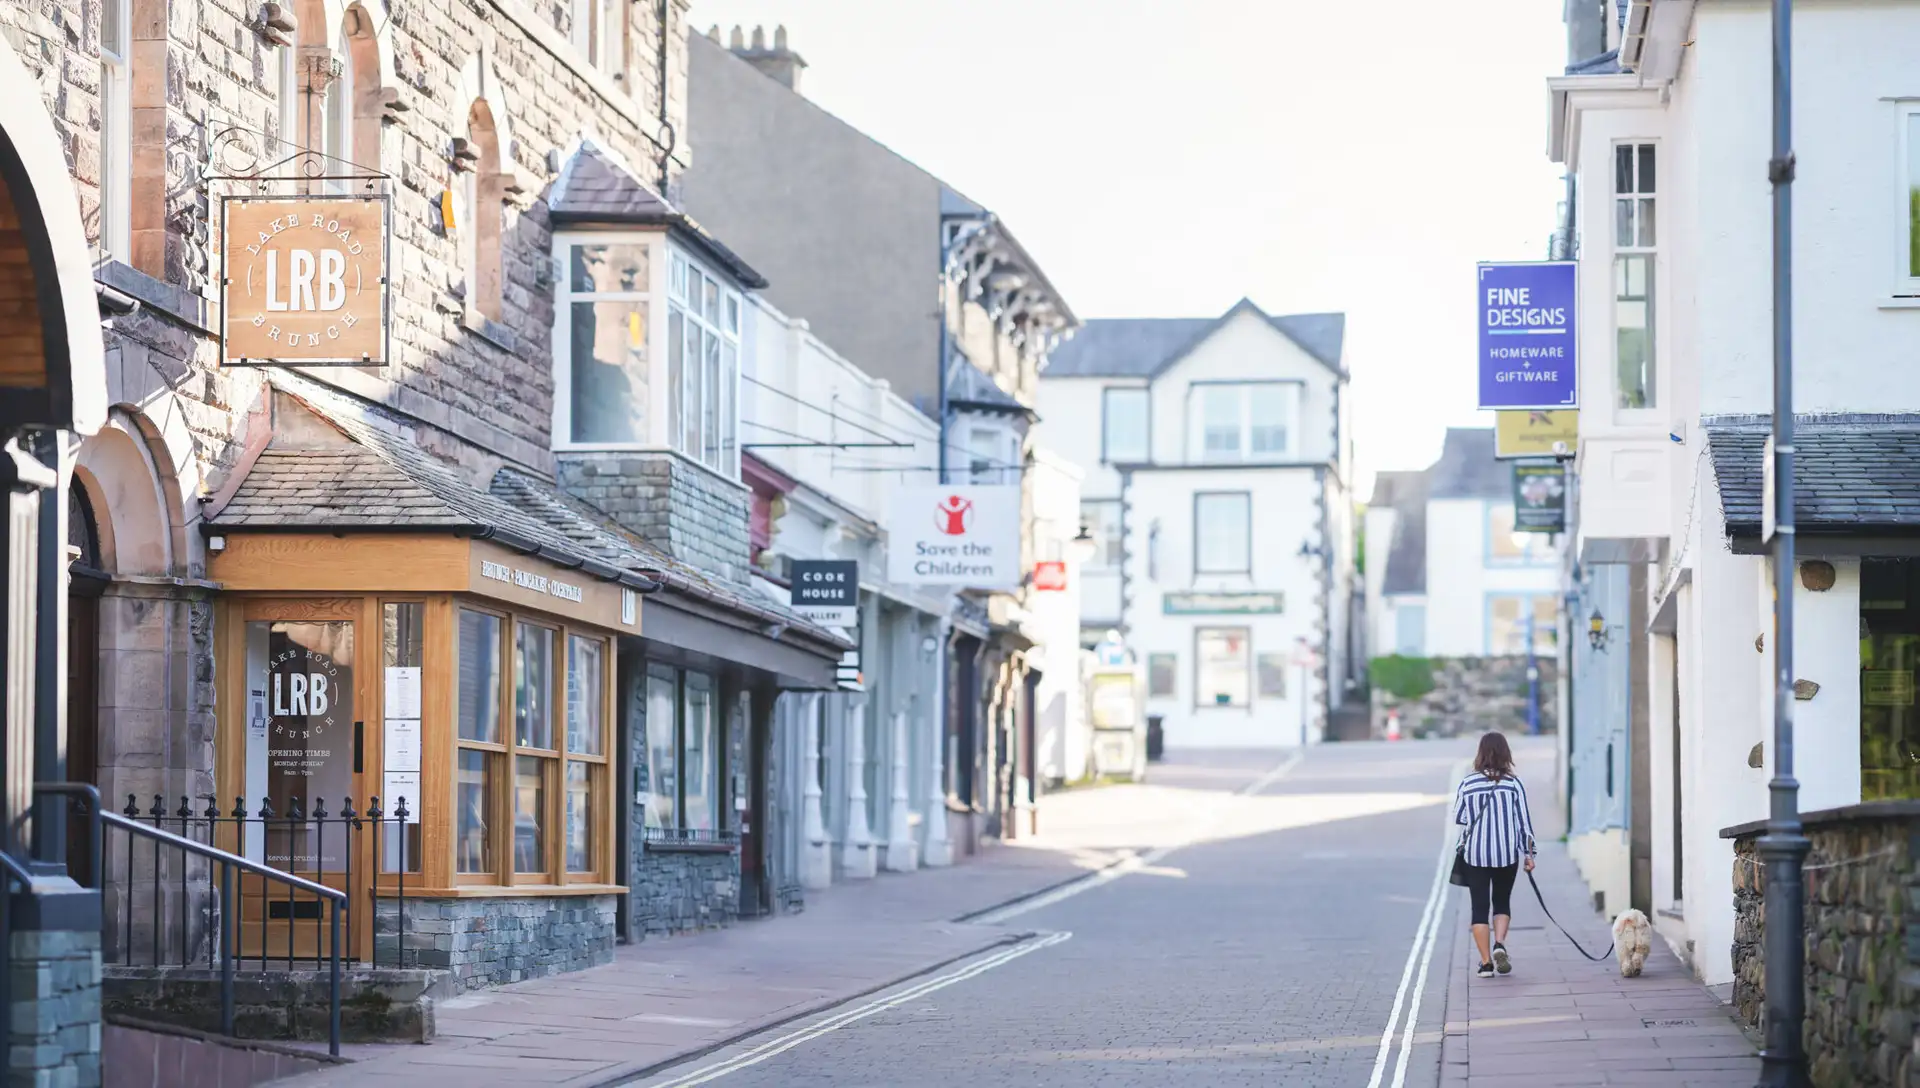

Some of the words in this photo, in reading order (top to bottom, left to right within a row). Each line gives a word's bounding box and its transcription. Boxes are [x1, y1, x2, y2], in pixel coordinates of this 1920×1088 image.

[246, 213, 300, 256] LAKE
[311, 213, 363, 256] ROAD
[266, 249, 346, 311] LRB
[1487, 287, 1530, 306] FINE
[1487, 307, 1566, 326] DESIGNS
[251, 311, 359, 347] BRUNCH
[1490, 346, 1564, 358] HOMEWARE
[1495, 371, 1558, 382] GIFTWARE
[915, 540, 957, 556] Save
[962, 541, 993, 556] the
[802, 572, 845, 582] COOK
[914, 560, 993, 576] Children
[802, 588, 845, 599] HOUSE
[262, 650, 297, 676] LAKE
[305, 650, 337, 676] ROAD
[274, 672, 328, 716] LRB
[266, 716, 335, 739] BRUNCH
[267, 749, 304, 757] OPENING
[305, 749, 331, 757] TIMES
